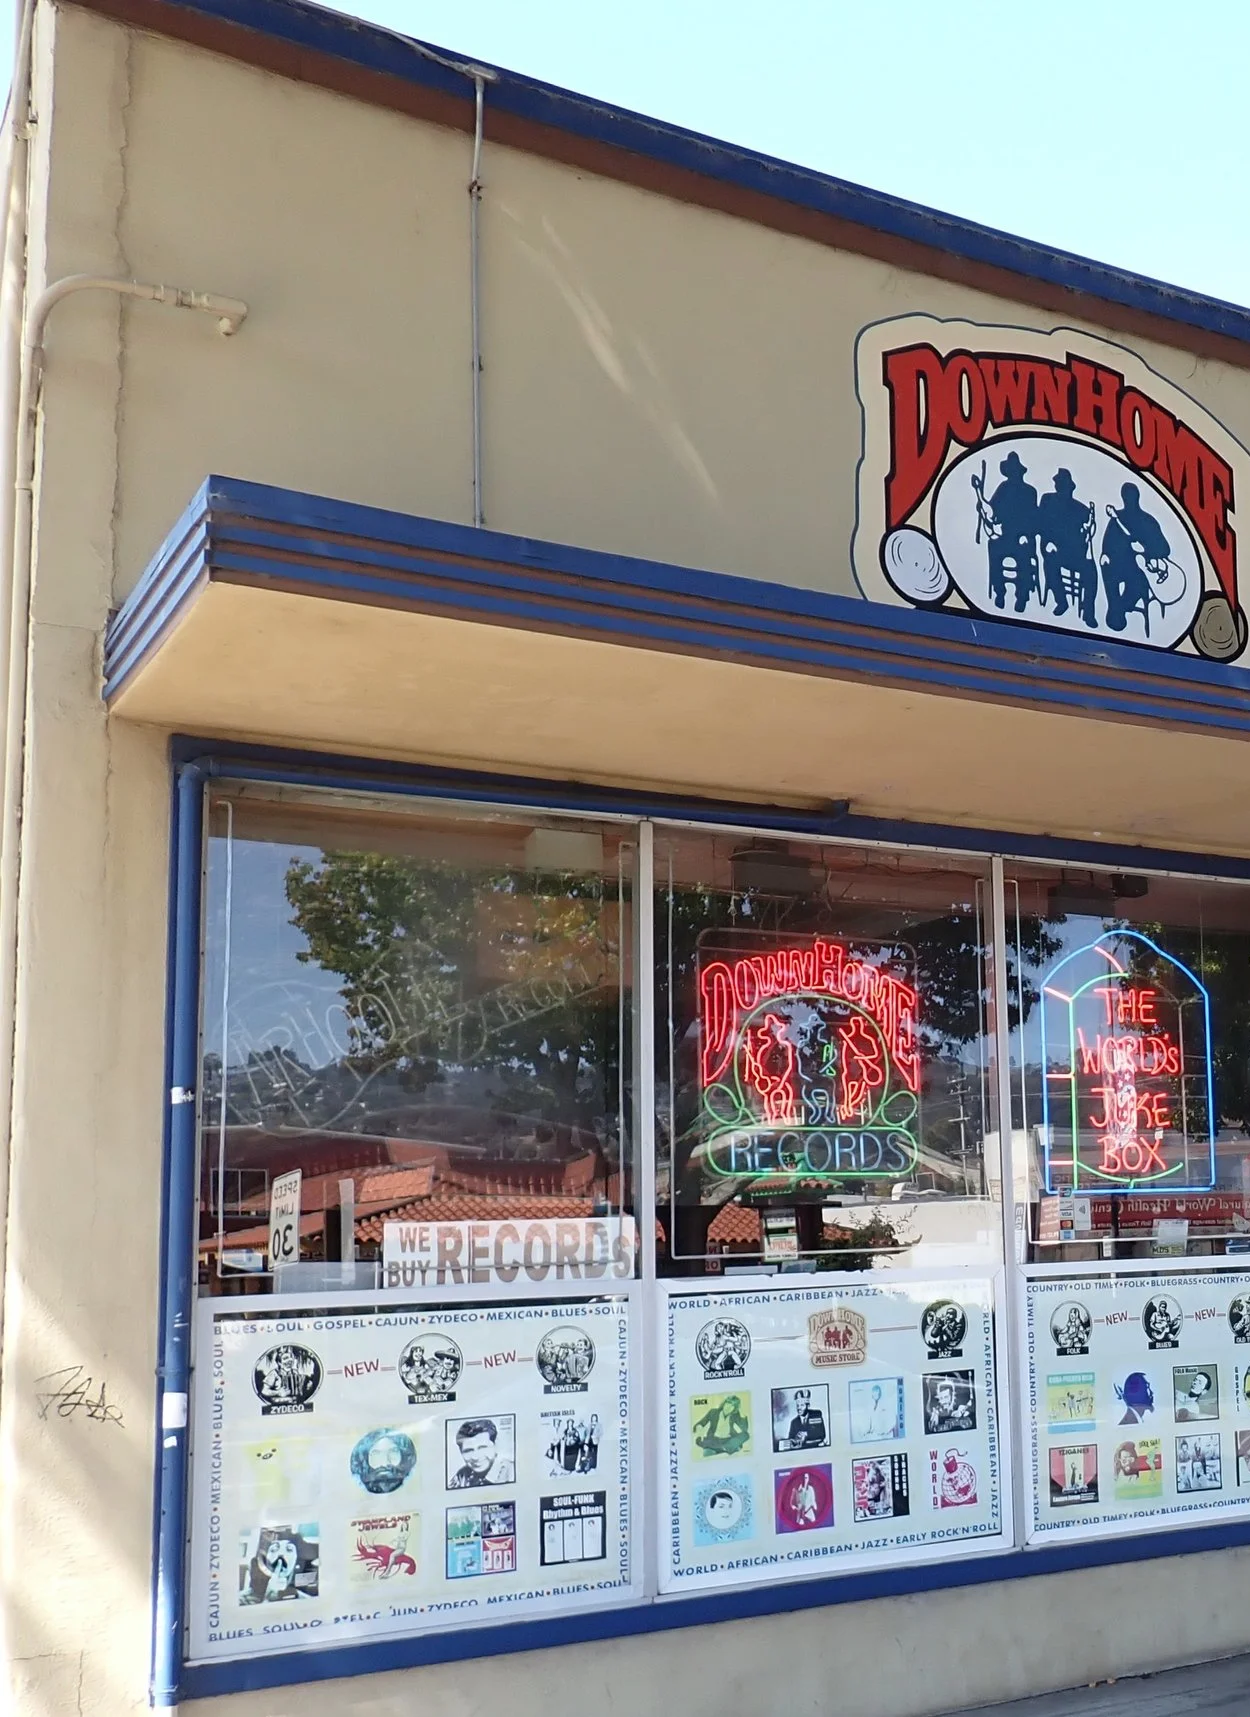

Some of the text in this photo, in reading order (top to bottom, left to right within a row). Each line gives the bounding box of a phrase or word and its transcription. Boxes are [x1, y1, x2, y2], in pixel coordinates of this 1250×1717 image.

[1093, 987, 1157, 1025] THE
[1090, 1087, 1170, 1128] JUKE
[729, 1131, 906, 1172] RECORDS
[1097, 1135, 1166, 1173] BOX
[399, 1226, 431, 1253] WE
[388, 1260, 431, 1288] BUY
[1027, 1284, 1069, 1293] COUNTRY
[1095, 1281, 1118, 1289] TIMEY
[1151, 1278, 1198, 1287] BLUEGRASS
[1202, 1276, 1240, 1284] COUNTRY
[668, 1299, 710, 1310] WORLD
[720, 1295, 770, 1305] AFRICAN
[779, 1290, 843, 1301] CARIBBEAN
[851, 1288, 878, 1297] JAZZ
[1195, 1307, 1216, 1321] NEW
[214, 1324, 257, 1335] BLUES
[314, 1319, 366, 1331] GOSPEL
[375, 1315, 419, 1327] CAJUN
[428, 1313, 478, 1324] ZYDECO
[487, 1309, 543, 1321] MEXICAN
[551, 1307, 587, 1317] BLUES
[595, 1305, 626, 1315] SOUL
[1106, 1311, 1128, 1326] NEW
[344, 1359, 380, 1377] NEW
[484, 1350, 517, 1368] NEW
[815, 1352, 860, 1363] MUSIC STORE
[984, 1344, 992, 1397] AFRICAN
[414, 1392, 448, 1403] TEX-MEX
[551, 1384, 581, 1393] NOVELTY
[1029, 1361, 1037, 1413] COUNTRY
[270, 1405, 305, 1414] ZYDECO
[669, 1403, 677, 1440] EARLY
[618, 1319, 628, 1576] CAJUN ZYDECO MEXICAN BLUES SOUL
[987, 1407, 997, 1478] CARIBBEAN
[1031, 1420, 1039, 1484] BLUEGRASS
[670, 1449, 679, 1480] JAZZ
[929, 1450, 939, 1506] WORLD
[208, 1341, 224, 1628] CAJUN ZYDECO MEXICAN BLUES SOUL
[543, 1505, 604, 1520] Rhythm & Blues
[553, 1493, 594, 1507] SOUL-FUNK
[991, 1488, 999, 1518] JAZZ
[1034, 1520, 1075, 1531] COUNTRY
[1082, 1517, 1099, 1525] OLD
[1102, 1513, 1128, 1522] TIMEY
[1134, 1509, 1156, 1518] FOLK
[1161, 1504, 1208, 1514] BLUEGRASS
[1212, 1497, 1250, 1508] COUNTRY
[671, 1491, 680, 1565] CARIBBEAN
[673, 1563, 718, 1577] WORLD
[727, 1555, 778, 1570] AFRICAN
[787, 1543, 853, 1561] CARIBBEAN
[861, 1538, 888, 1549] JAZZ
[896, 1533, 927, 1544] EARLY
[553, 1584, 588, 1595] BLUES
